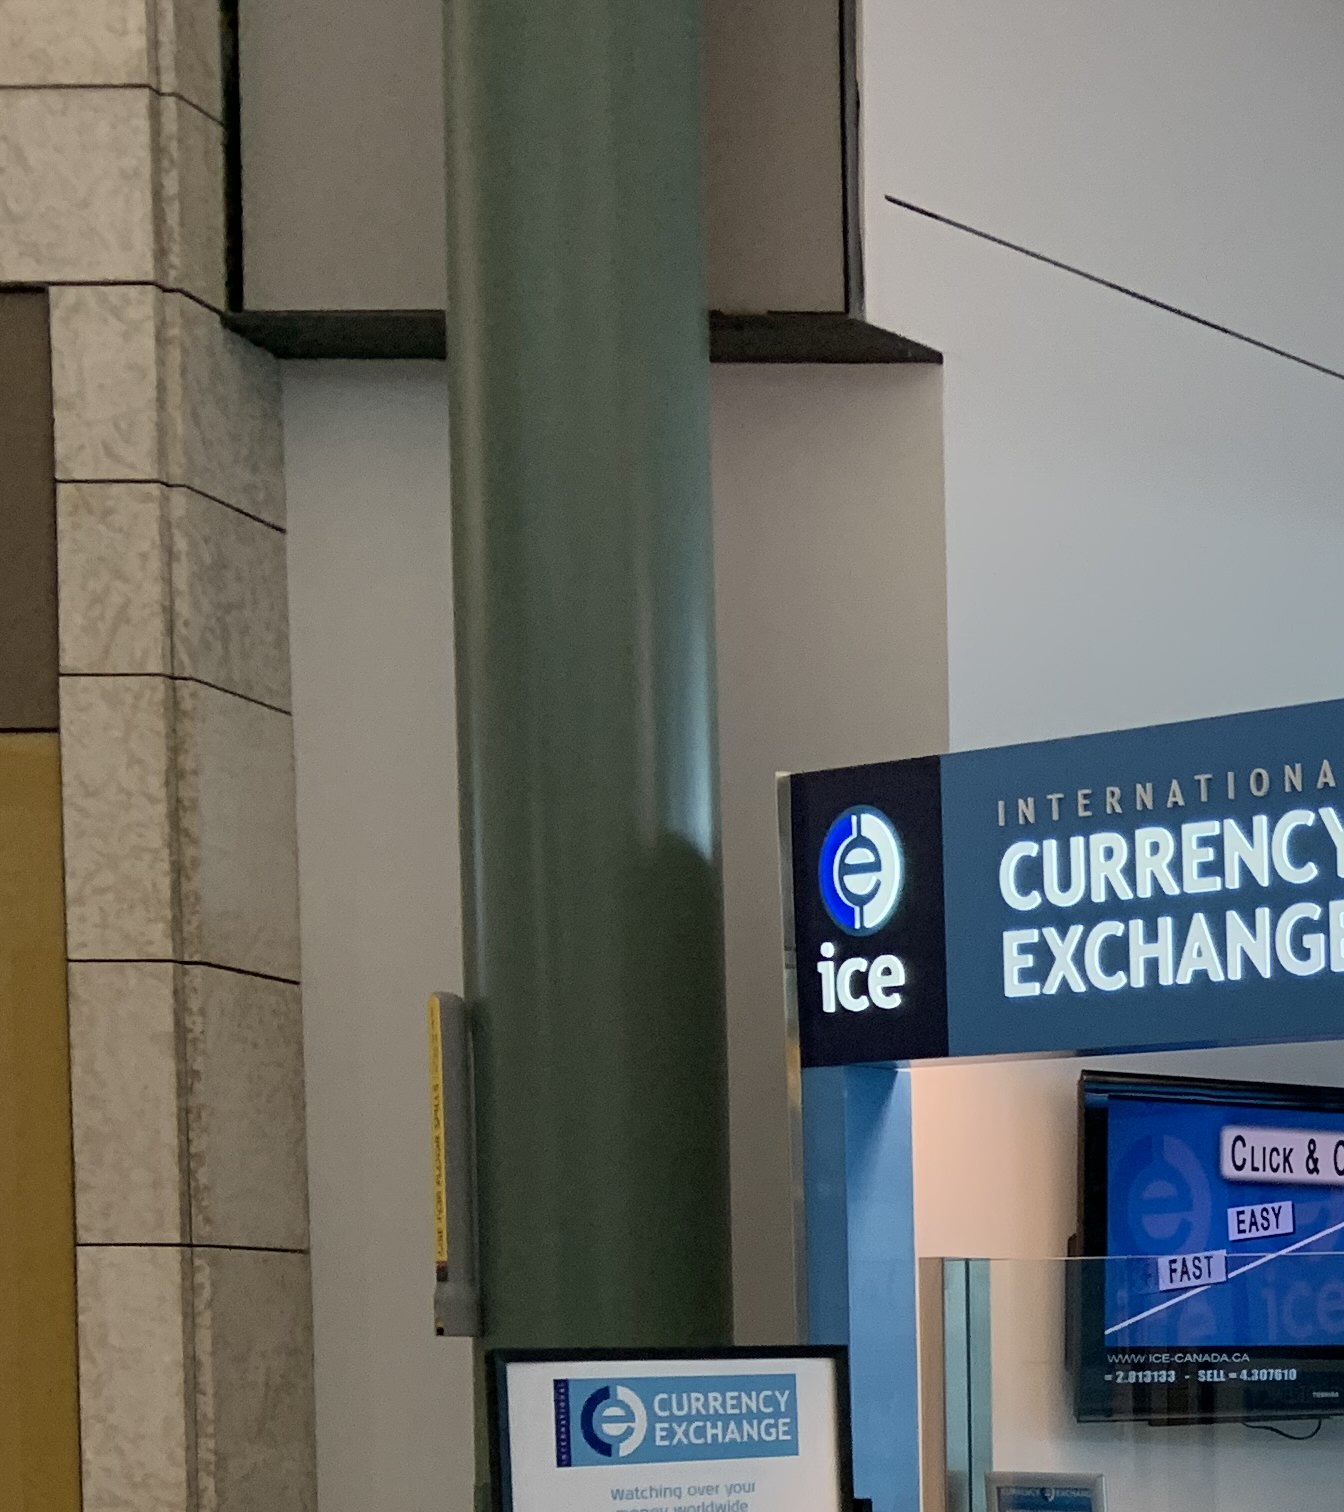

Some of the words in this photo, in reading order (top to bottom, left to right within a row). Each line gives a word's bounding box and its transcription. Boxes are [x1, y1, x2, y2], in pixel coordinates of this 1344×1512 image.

[817, 943, 904, 1012] ice
[1305, 1138, 1320, 1175] &
[1236, 1205, 1283, 1235] EASY
[1168, 1255, 1213, 1284] FAST
[1198, 1370, 1226, 1381] SELL
[653, 1390, 791, 1417] CURRENCY
[655, 1418, 792, 1446] EXCHANGE
[611, 1485, 682, 1501] Watching
[687, 1484, 719, 1497] over
[724, 1482, 756, 1497] your
